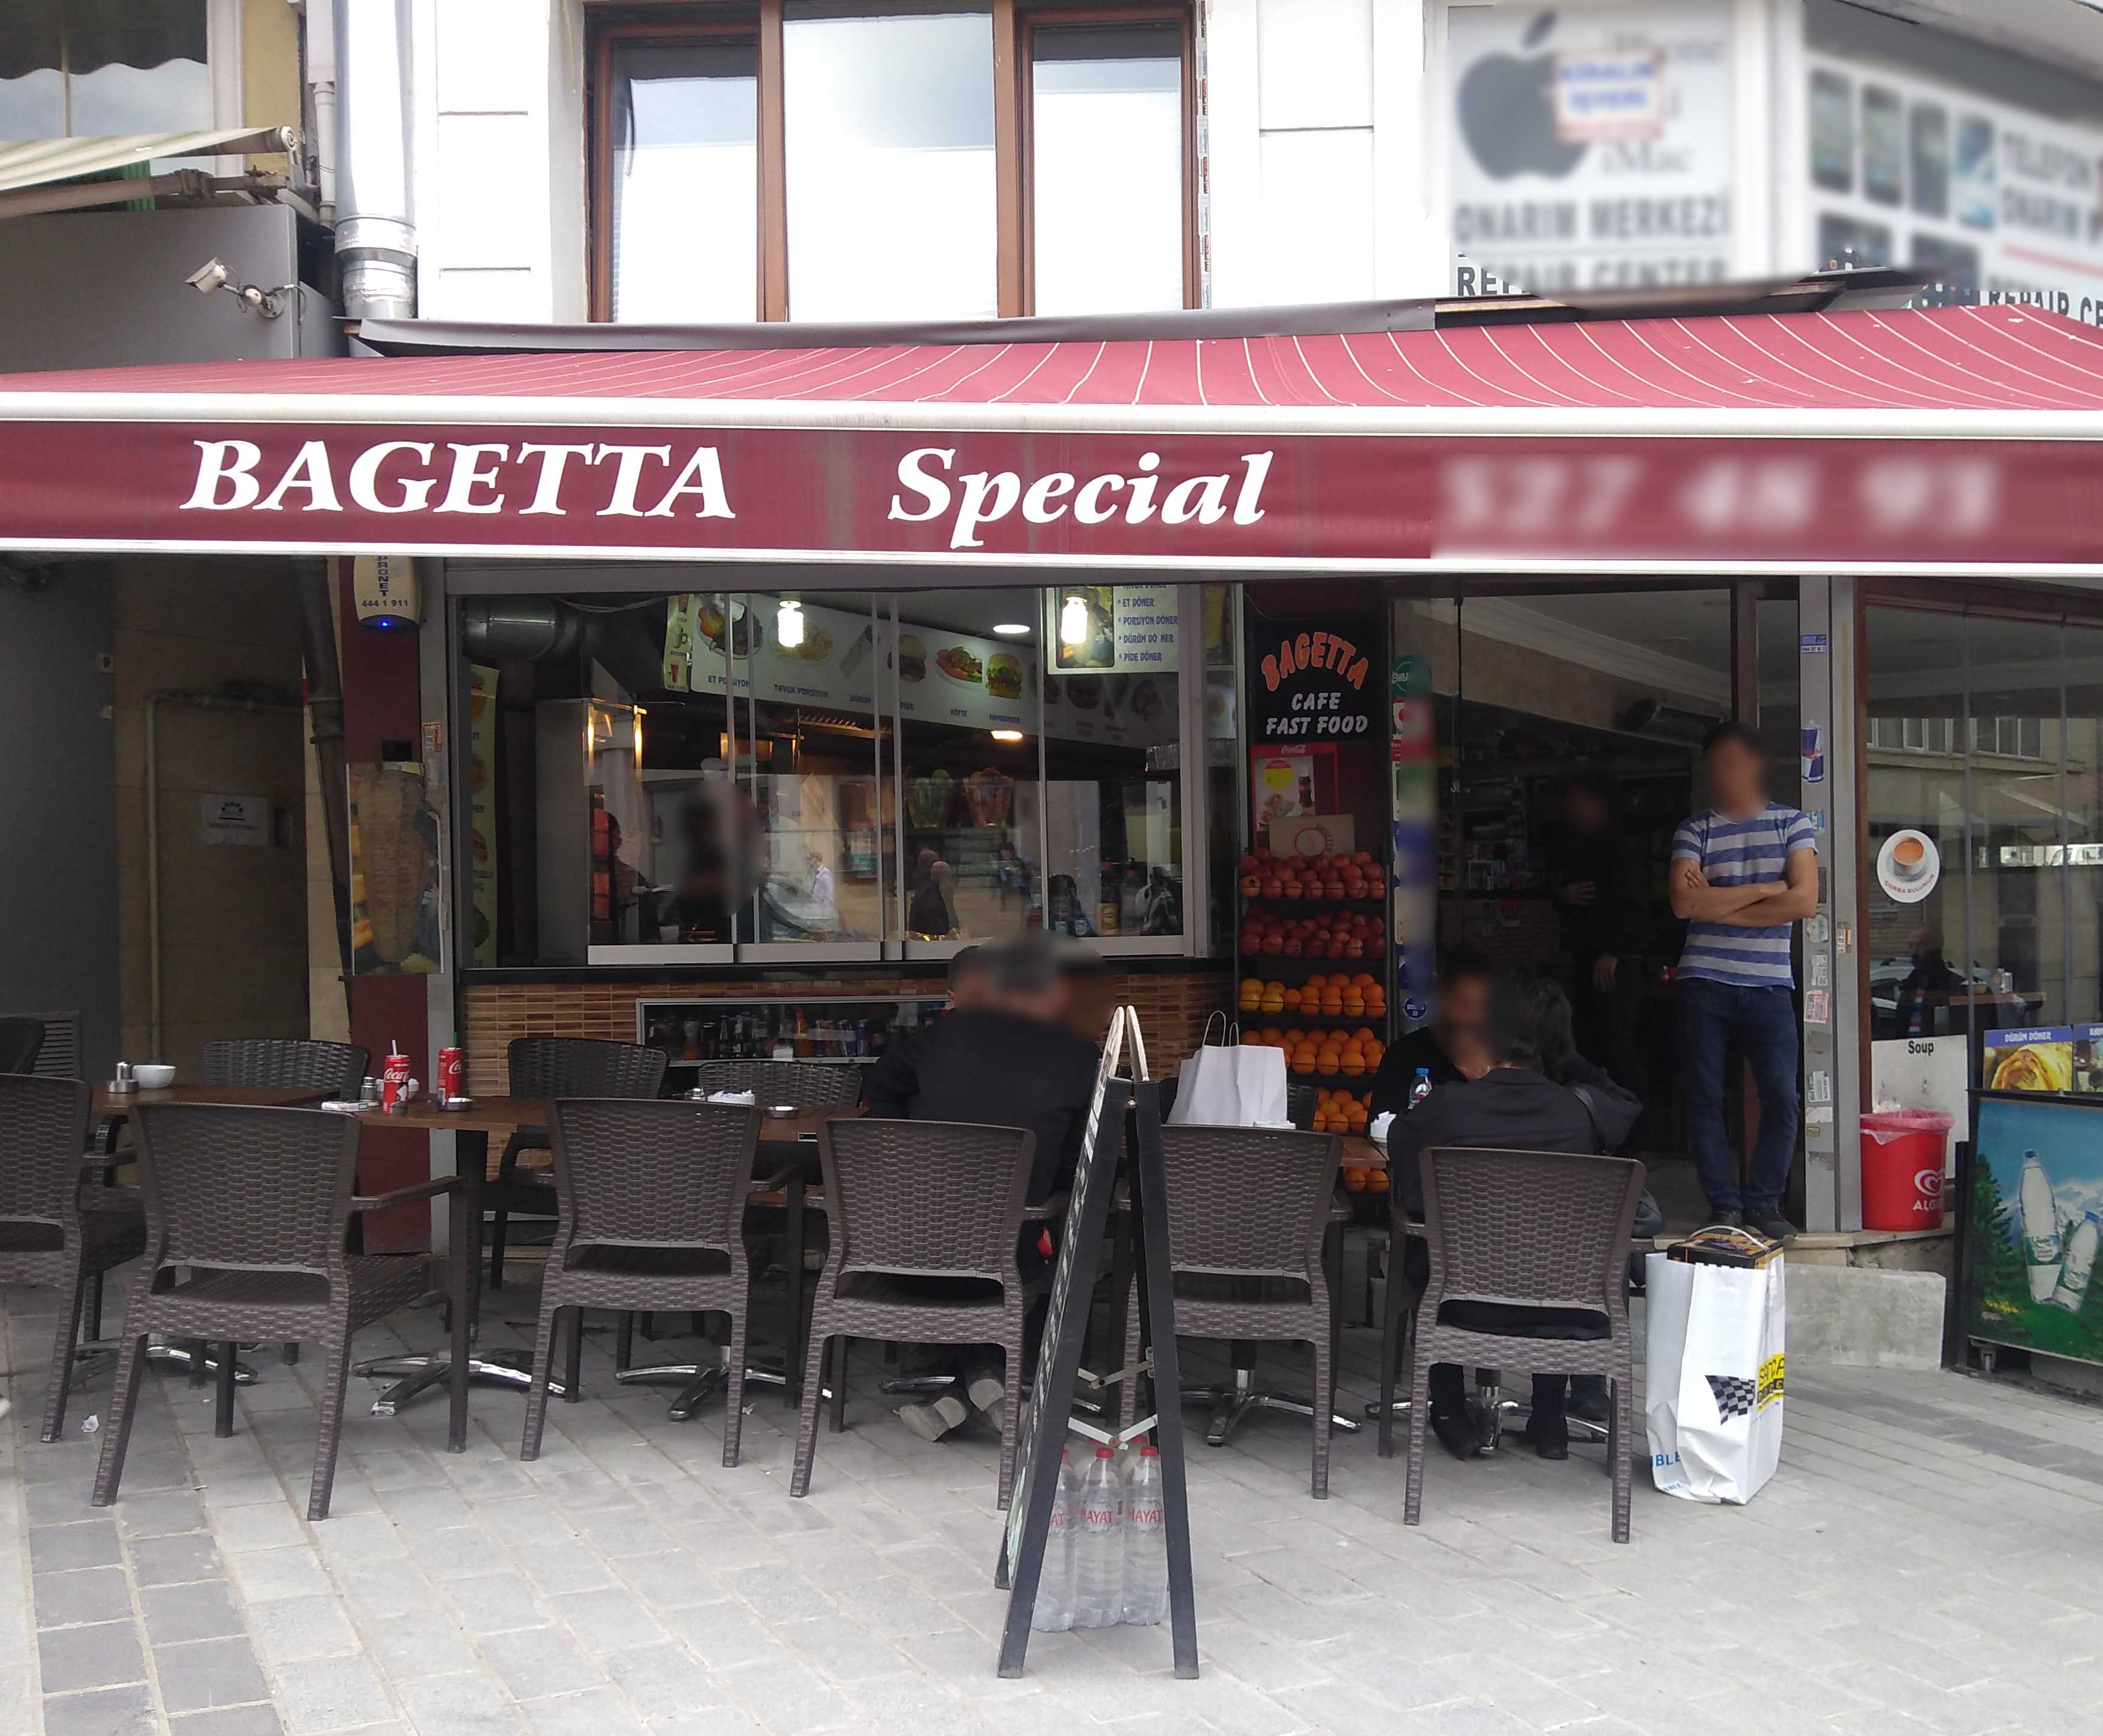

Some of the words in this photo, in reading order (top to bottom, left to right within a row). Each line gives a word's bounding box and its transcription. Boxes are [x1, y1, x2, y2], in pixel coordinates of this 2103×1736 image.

[179, 440, 736, 519] BAGETTA
[887, 448, 1273, 549] Special
[1123, 598, 1131, 607] ET
[1261, 632, 1369, 691] BAGETTA
[1291, 692, 1341, 710] CAFE
[1266, 718, 1311, 735] FAST
[1316, 715, 1368, 734] FOOD
[1908, 1040, 1935, 1056] Soup
[1080, 1509, 1113, 1524] HAYAT
[1127, 1508, 1164, 1524] HAYAT
